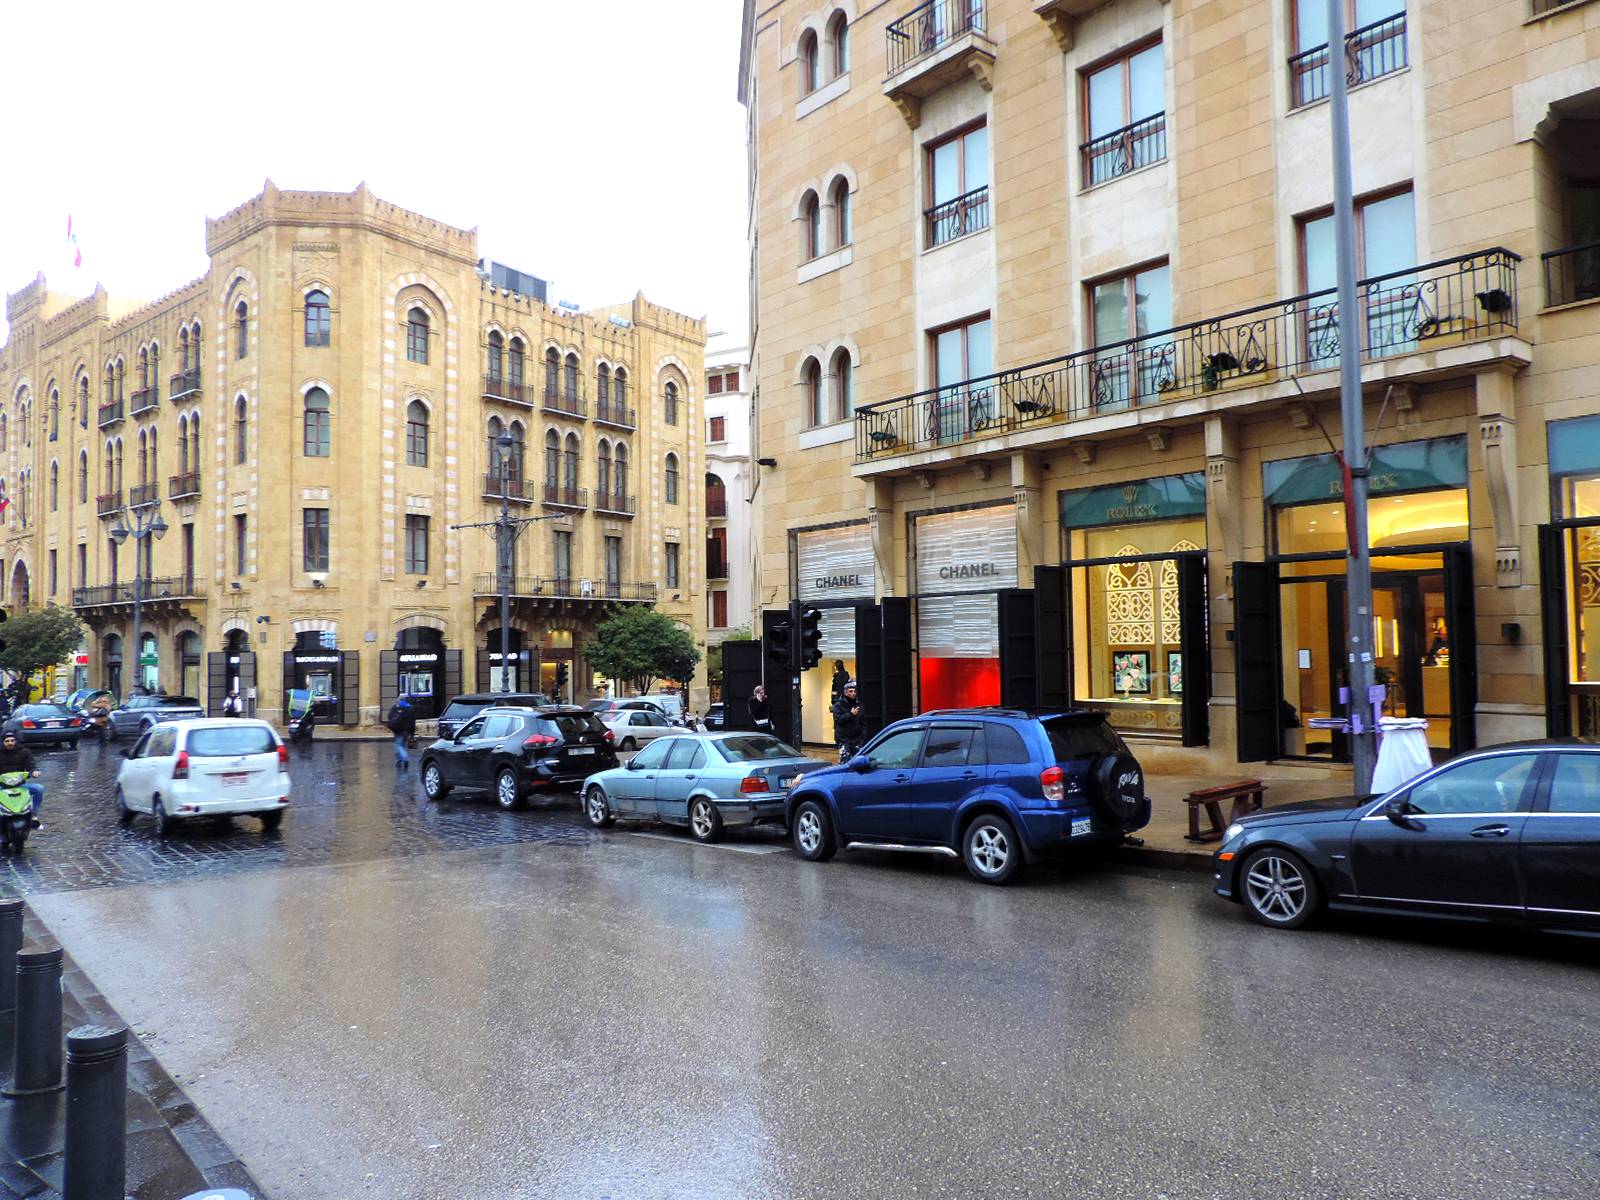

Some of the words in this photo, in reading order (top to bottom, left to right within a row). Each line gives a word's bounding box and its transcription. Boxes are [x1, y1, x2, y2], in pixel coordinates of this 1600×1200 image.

[1106, 504, 1159, 520] ROLEX
[939, 563, 1000, 579] CHANEL
[815, 574, 862, 588] CHANEL
